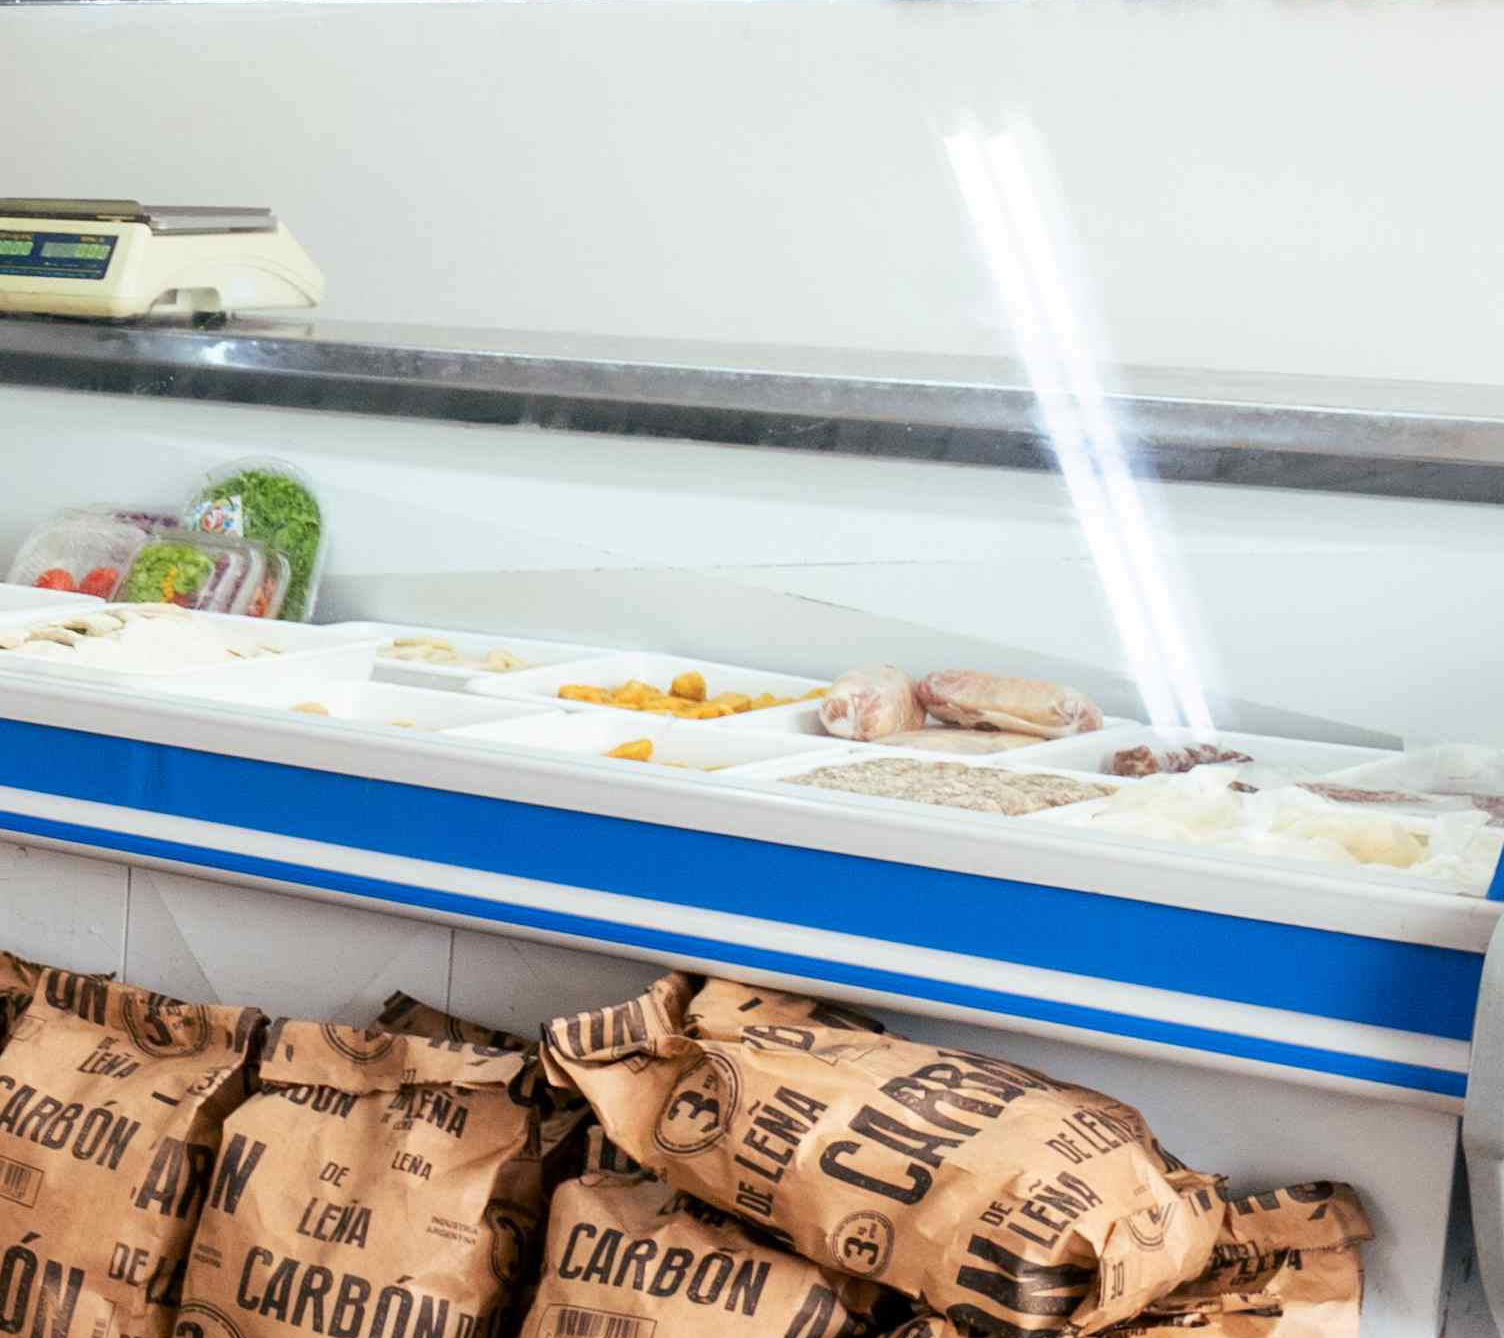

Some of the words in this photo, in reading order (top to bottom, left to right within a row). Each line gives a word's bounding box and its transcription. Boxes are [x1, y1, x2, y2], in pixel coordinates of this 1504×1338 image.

[744, 1084, 828, 1185] LEÑA
[1045, 1131, 1080, 1165] DE
[319, 1160, 350, 1188] DE
[391, 1147, 433, 1182] LEÑA
[735, 1171, 773, 1217] DE
[979, 1199, 1015, 1228] DE
[1006, 1170, 1103, 1250] LEÑA
[296, 1196, 373, 1250] LEÑA
[109, 1241, 149, 1288] DE
[558, 1222, 772, 1317] CARBÓN
